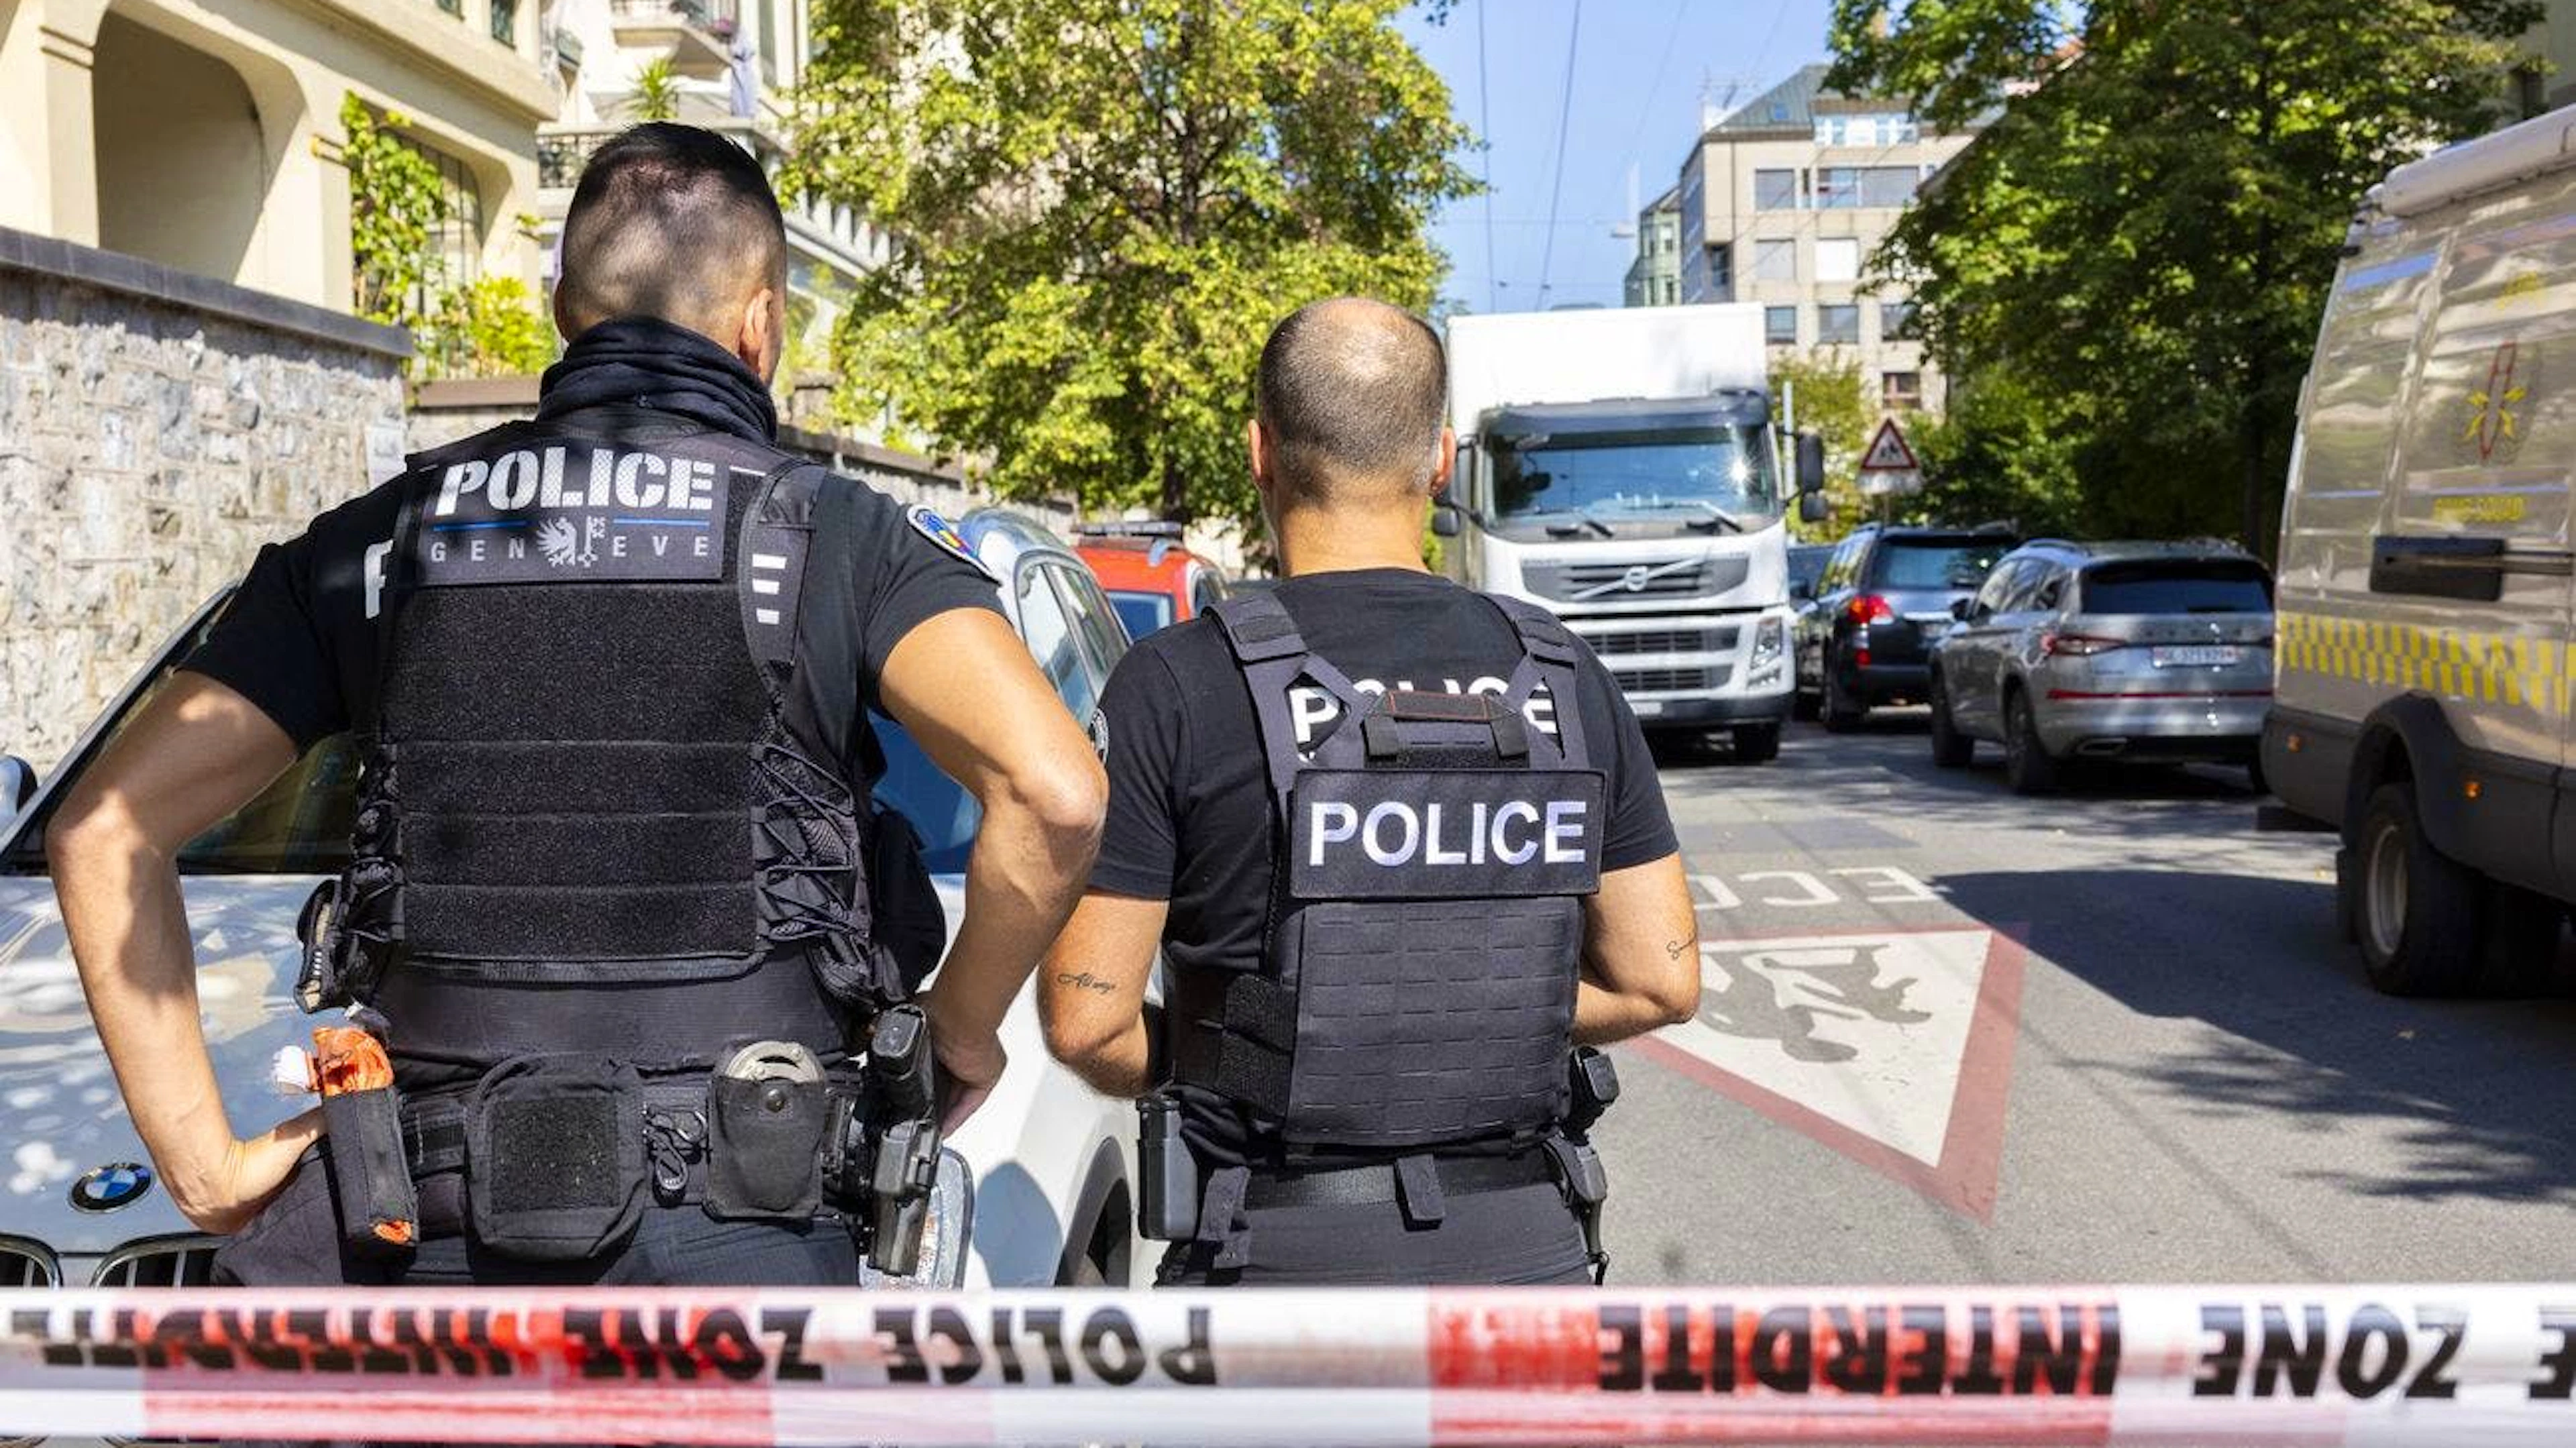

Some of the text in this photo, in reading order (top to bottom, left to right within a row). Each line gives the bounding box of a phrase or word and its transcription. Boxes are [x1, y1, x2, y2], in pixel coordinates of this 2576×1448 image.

[435, 446, 715, 516] POLICE
[1309, 801, 1587, 867] POLICE
[873, 1308, 1217, 1386] POLICE
[1599, 1304, 2121, 1395] INTERDITE
[2192, 1304, 2469, 1400] ZONE
